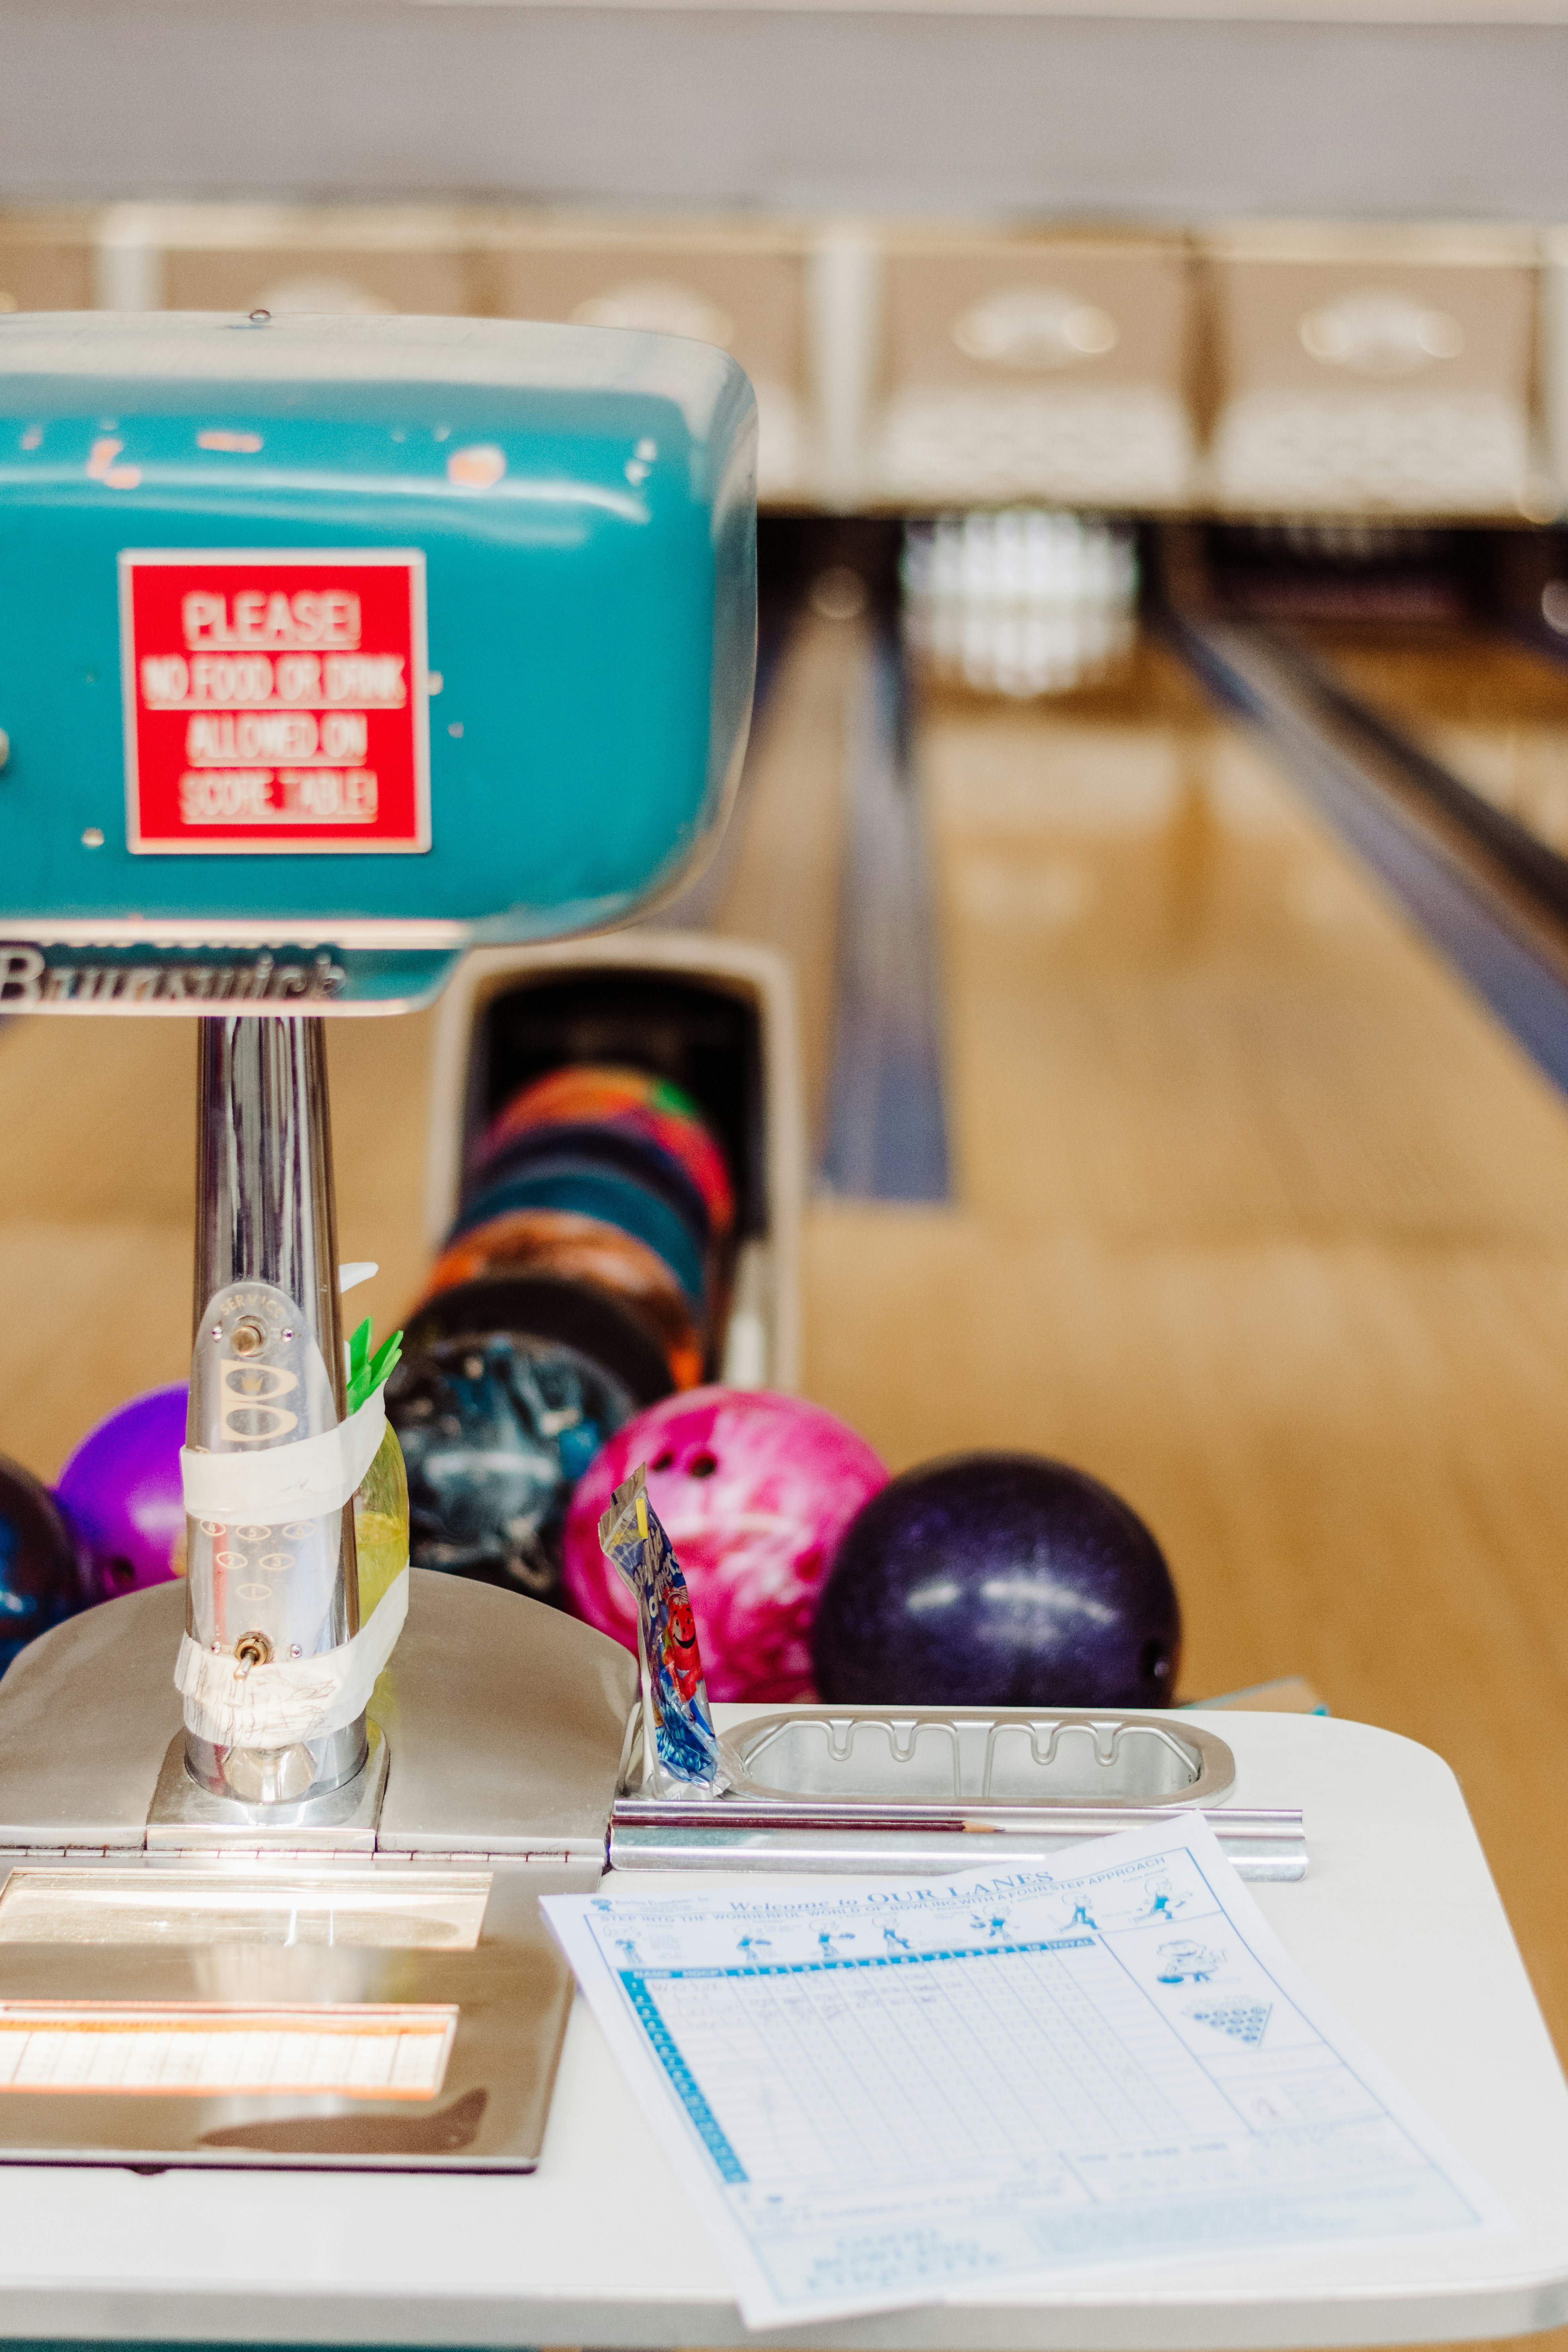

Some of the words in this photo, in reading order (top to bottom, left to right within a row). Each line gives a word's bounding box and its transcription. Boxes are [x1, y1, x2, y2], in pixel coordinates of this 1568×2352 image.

[182, 590, 362, 650] PLEASE!
[141, 653, 189, 708] NO
[190, 653, 274, 708] FOOD
[276, 653, 322, 708] OR
[324, 653, 408, 708] DRINK
[185, 712, 319, 766] ALLOWED
[321, 712, 368, 766] ON
[179, 768, 275, 823] SCORE
[277, 768, 379, 823] TABLE!
[220, 1294, 287, 1318] SERVICE
[712, 1911, 800, 1921] WONDERFUL
[810, 1907, 861, 1916] WORLD
[890, 1899, 957, 1911] BOWLING
[960, 1895, 995, 1905] WITH
[1009, 1885, 1048, 1898] FOUR
[1050, 1880, 1085, 1891] STEP
[1089, 1856, 1166, 1885] APPROACH
[730, 1900, 829, 1911] Welcome
[839, 1897, 858, 1906] to
[867, 1889, 936, 1903] OUR
[947, 1871, 1053, 1897] LANES
[1052, 1938, 1092, 1949] TOTAL
